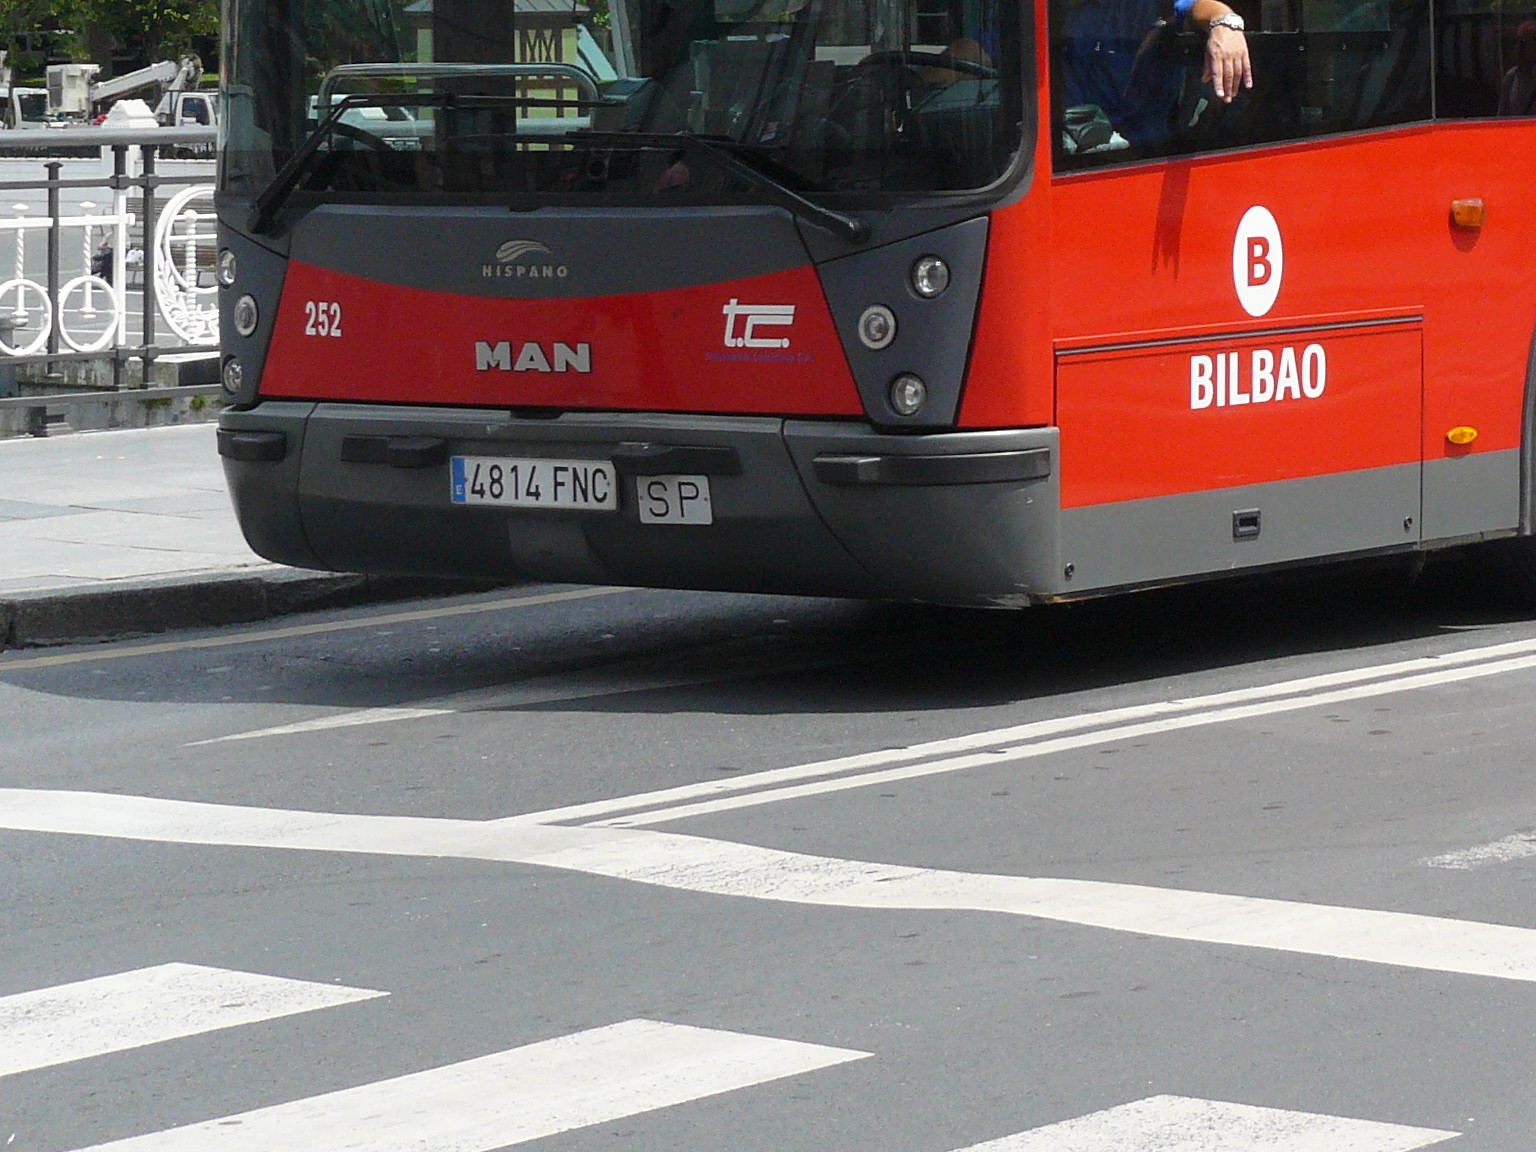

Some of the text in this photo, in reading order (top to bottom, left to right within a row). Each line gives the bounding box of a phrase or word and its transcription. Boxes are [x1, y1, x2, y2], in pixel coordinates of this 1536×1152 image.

[482, 264, 569, 278] HISPANO
[1246, 235, 1272, 288] B
[305, 301, 342, 337] 252
[475, 341, 592, 373] MAN
[1190, 343, 1327, 410] BILBAO
[470, 463, 542, 501] 4814
[552, 466, 609, 504] FNC
